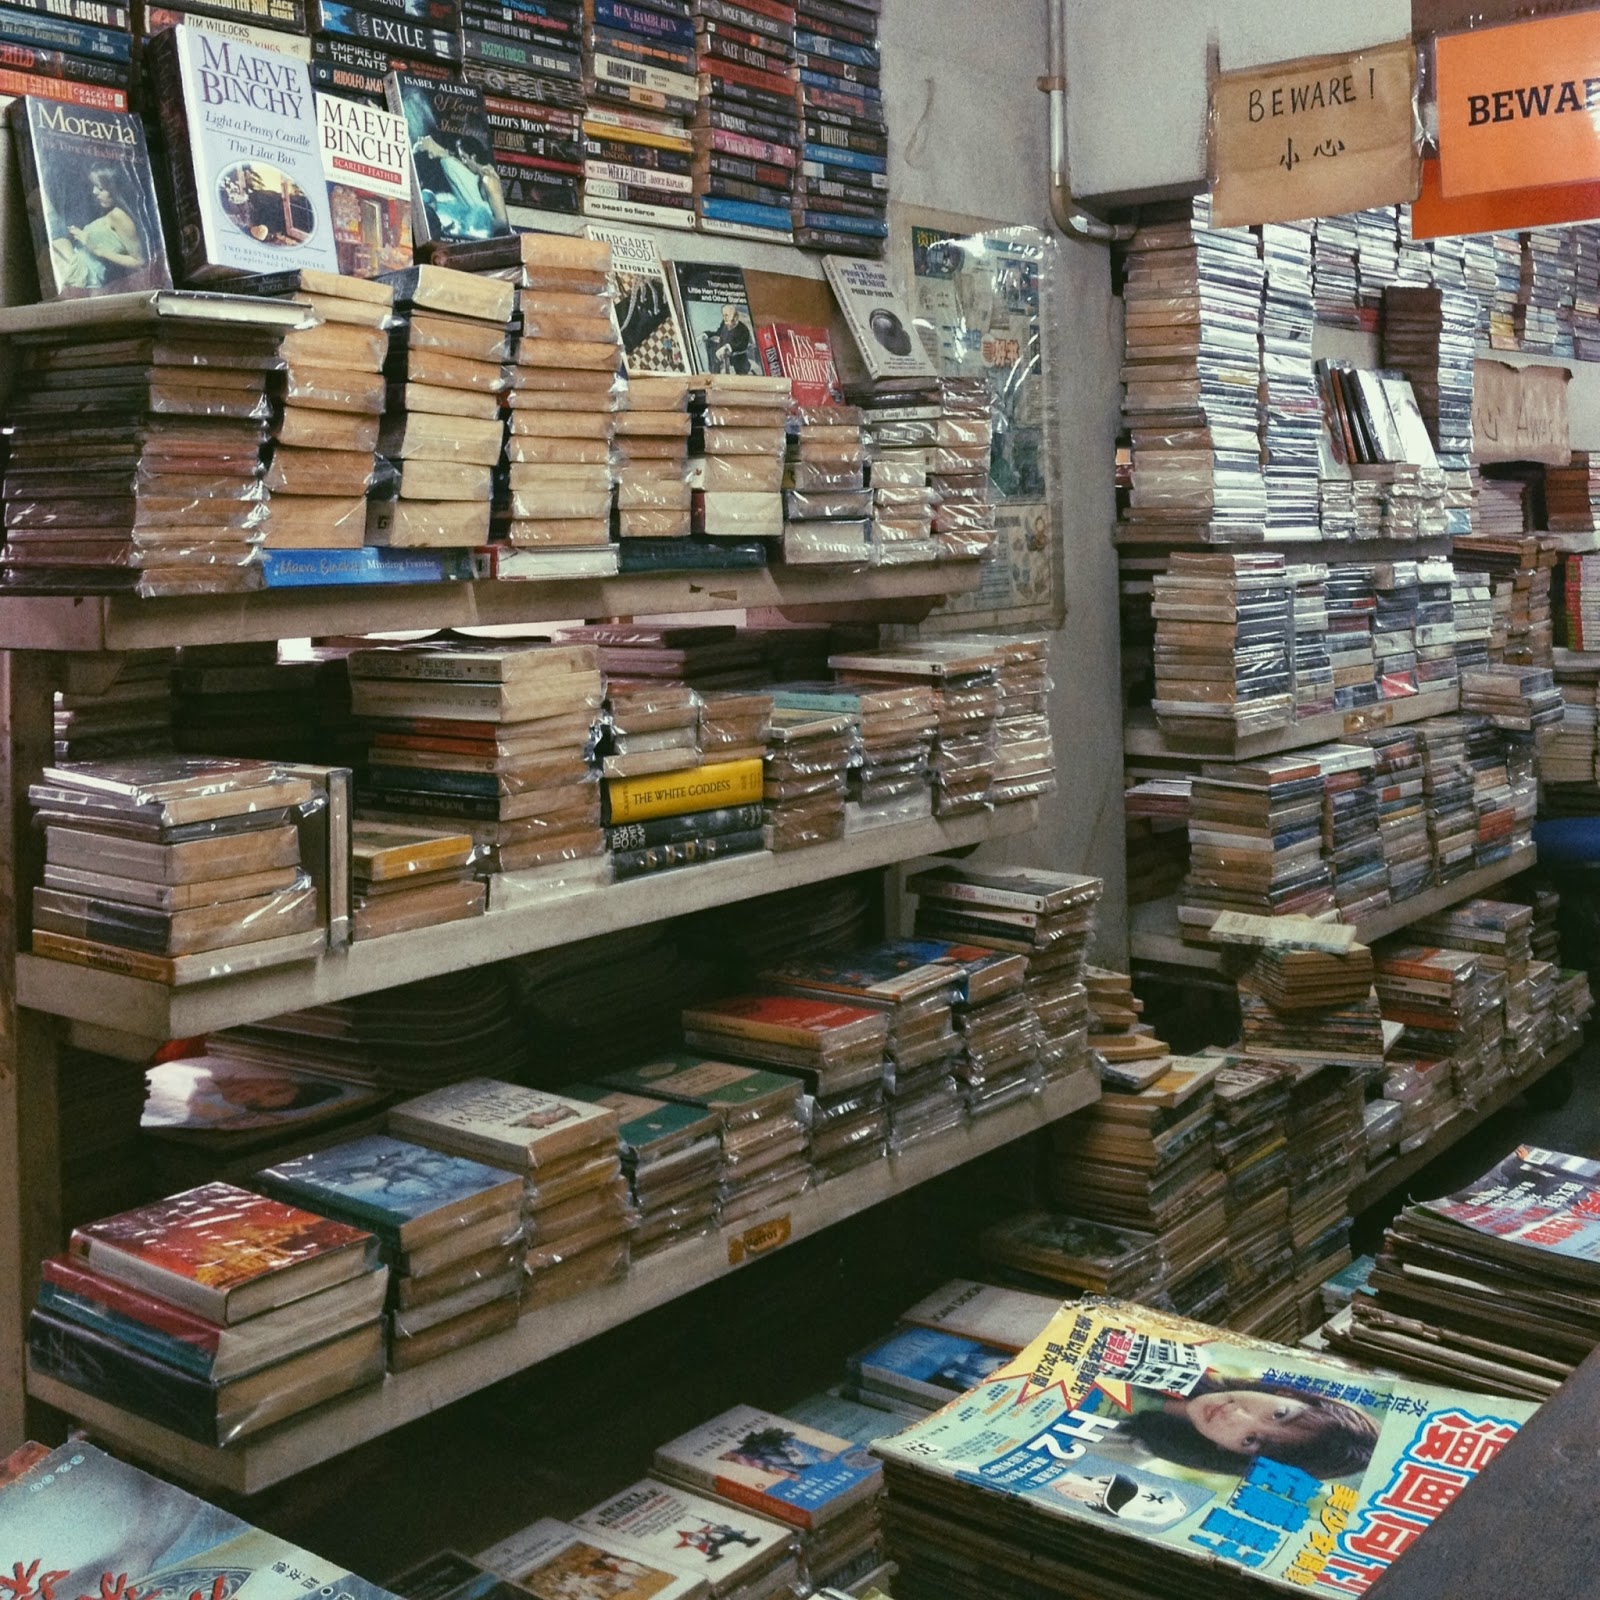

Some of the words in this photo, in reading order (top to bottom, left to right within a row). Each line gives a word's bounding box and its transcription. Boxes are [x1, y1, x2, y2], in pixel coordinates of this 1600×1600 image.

[75, 1, 109, 24] JOSEPH
[188, 16, 204, 28] TIM
[206, 21, 250, 39] WILLOCKS
[371, 18, 427, 50] EXILE
[198, 34, 301, 94] MAEVE
[330, 41, 371, 59] EMPIRE
[373, 51, 388, 61] OF
[332, 52, 354, 64] THE
[356, 58, 388, 72] ANTS
[333, 70, 365, 90] RUDOLFO
[403, 76, 436, 90] ISABEL
[438, 83, 478, 98] ALLENDE
[73, 87, 114, 101] CRACKED
[198, 68, 304, 121] BINCHY
[37, 102, 137, 145] Moravia
[205, 111, 232, 130] Light
[234, 121, 242, 130] a
[243, 120, 273, 141] Penny
[275, 128, 311, 147] Candle
[324, 99, 406, 144] MAEVE
[486, 115, 519, 130] ARLOT'S
[520, 119, 545, 134] MOON
[227, 138, 248, 153] The
[277, 151, 296, 167] Bus
[324, 125, 406, 169] BINCHY
[334, 158, 367, 174] SCARLET
[367, 166, 401, 183] FEATHER
[591, 231, 656, 258] MARGARET
[619, 264, 646, 274] BEFORE
[706, 280, 729, 289] Thomas
[787, 329, 815, 359] TESS
[416, 658, 433, 668] THE
[434, 659, 456, 669] LYRE
[633, 793, 653, 805] THE
[654, 787, 686, 801] WHITE
[688, 780, 731, 797] GODDESS
[1026, 1409, 1121, 1461] H2
[783, 1474, 821, 1501] CAROL
[805, 1470, 855, 1501] SHIELDS
